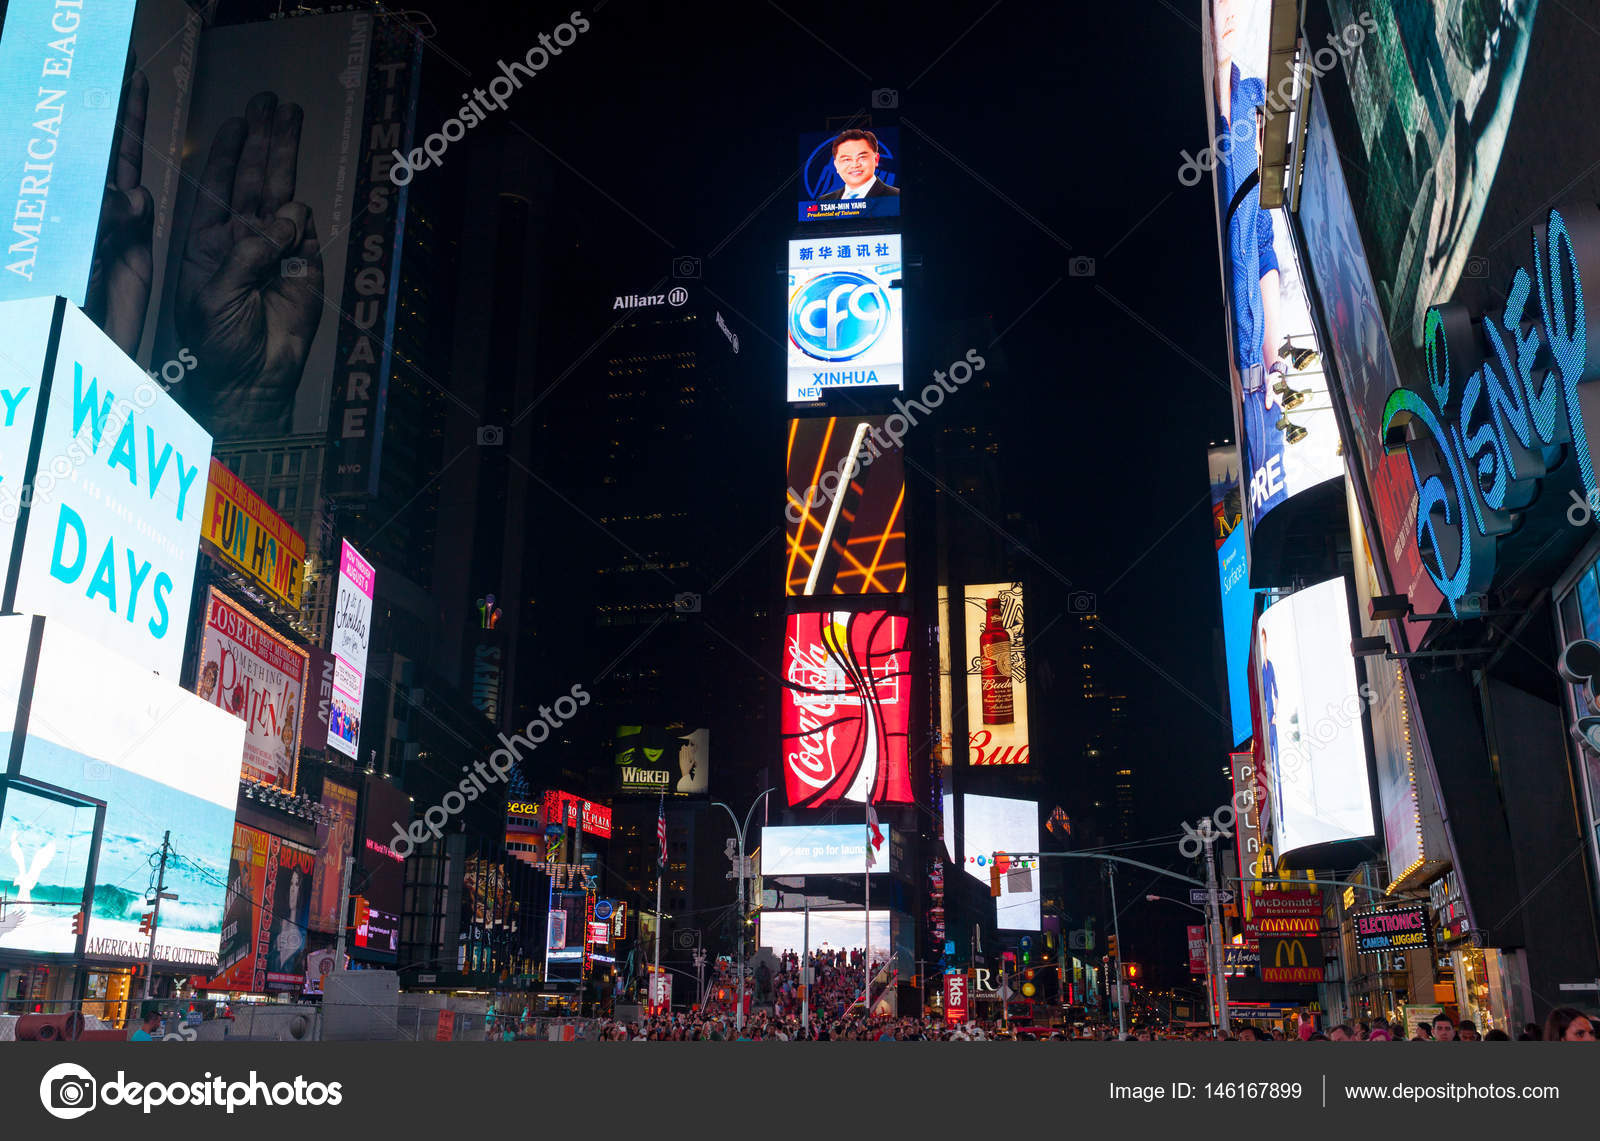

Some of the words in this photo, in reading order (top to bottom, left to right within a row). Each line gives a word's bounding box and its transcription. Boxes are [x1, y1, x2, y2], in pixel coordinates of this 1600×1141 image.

[368, 60, 408, 214] TIMES
[5, 87, 67, 281] AMERICAN
[807, 210, 834, 218] Prudential
[841, 209, 860, 217] Taiwan
[820, 202, 849, 212] TSAN-MIN
[851, 200, 867, 210] YANG
[799, 243, 889, 261] 新华通讯社
[613, 293, 665, 310] Allianz
[342, 234, 386, 438] SQUARE
[813, 370, 880, 386] XINHUA
[73, 360, 198, 522] WAVY
[337, 464, 361, 475] NYC
[210, 491, 249, 562] FUN
[252, 526, 298, 600] HOME
[50, 503, 174, 639] DAYS
[209, 600, 259, 652] LOSER!
[228, 639, 283, 686] SOMETHING
[316, 659, 335, 726] NEW
[591, 814, 610, 828] PLAZA
[1241, 766, 1258, 876] PALAC
[280, 846, 316, 876] BRANDY
[812, 847, 824, 858] go
[825, 844, 839, 856] for
[841, 844, 867, 856] launc
[253, 835, 281, 991] CHICAGO
[1255, 898, 1321, 907] McDonald's
[1359, 911, 1422, 935] ELECTRONICS
[88, 937, 142, 959] AMERICAN
[144, 943, 171, 961] EGLE
[172, 945, 219, 966] OUTFITTERS
[1362, 936, 1390, 948] CAMERA
[1392, 932, 1425, 946] LUGGAGE
[950, 977, 964, 1006] tkts
